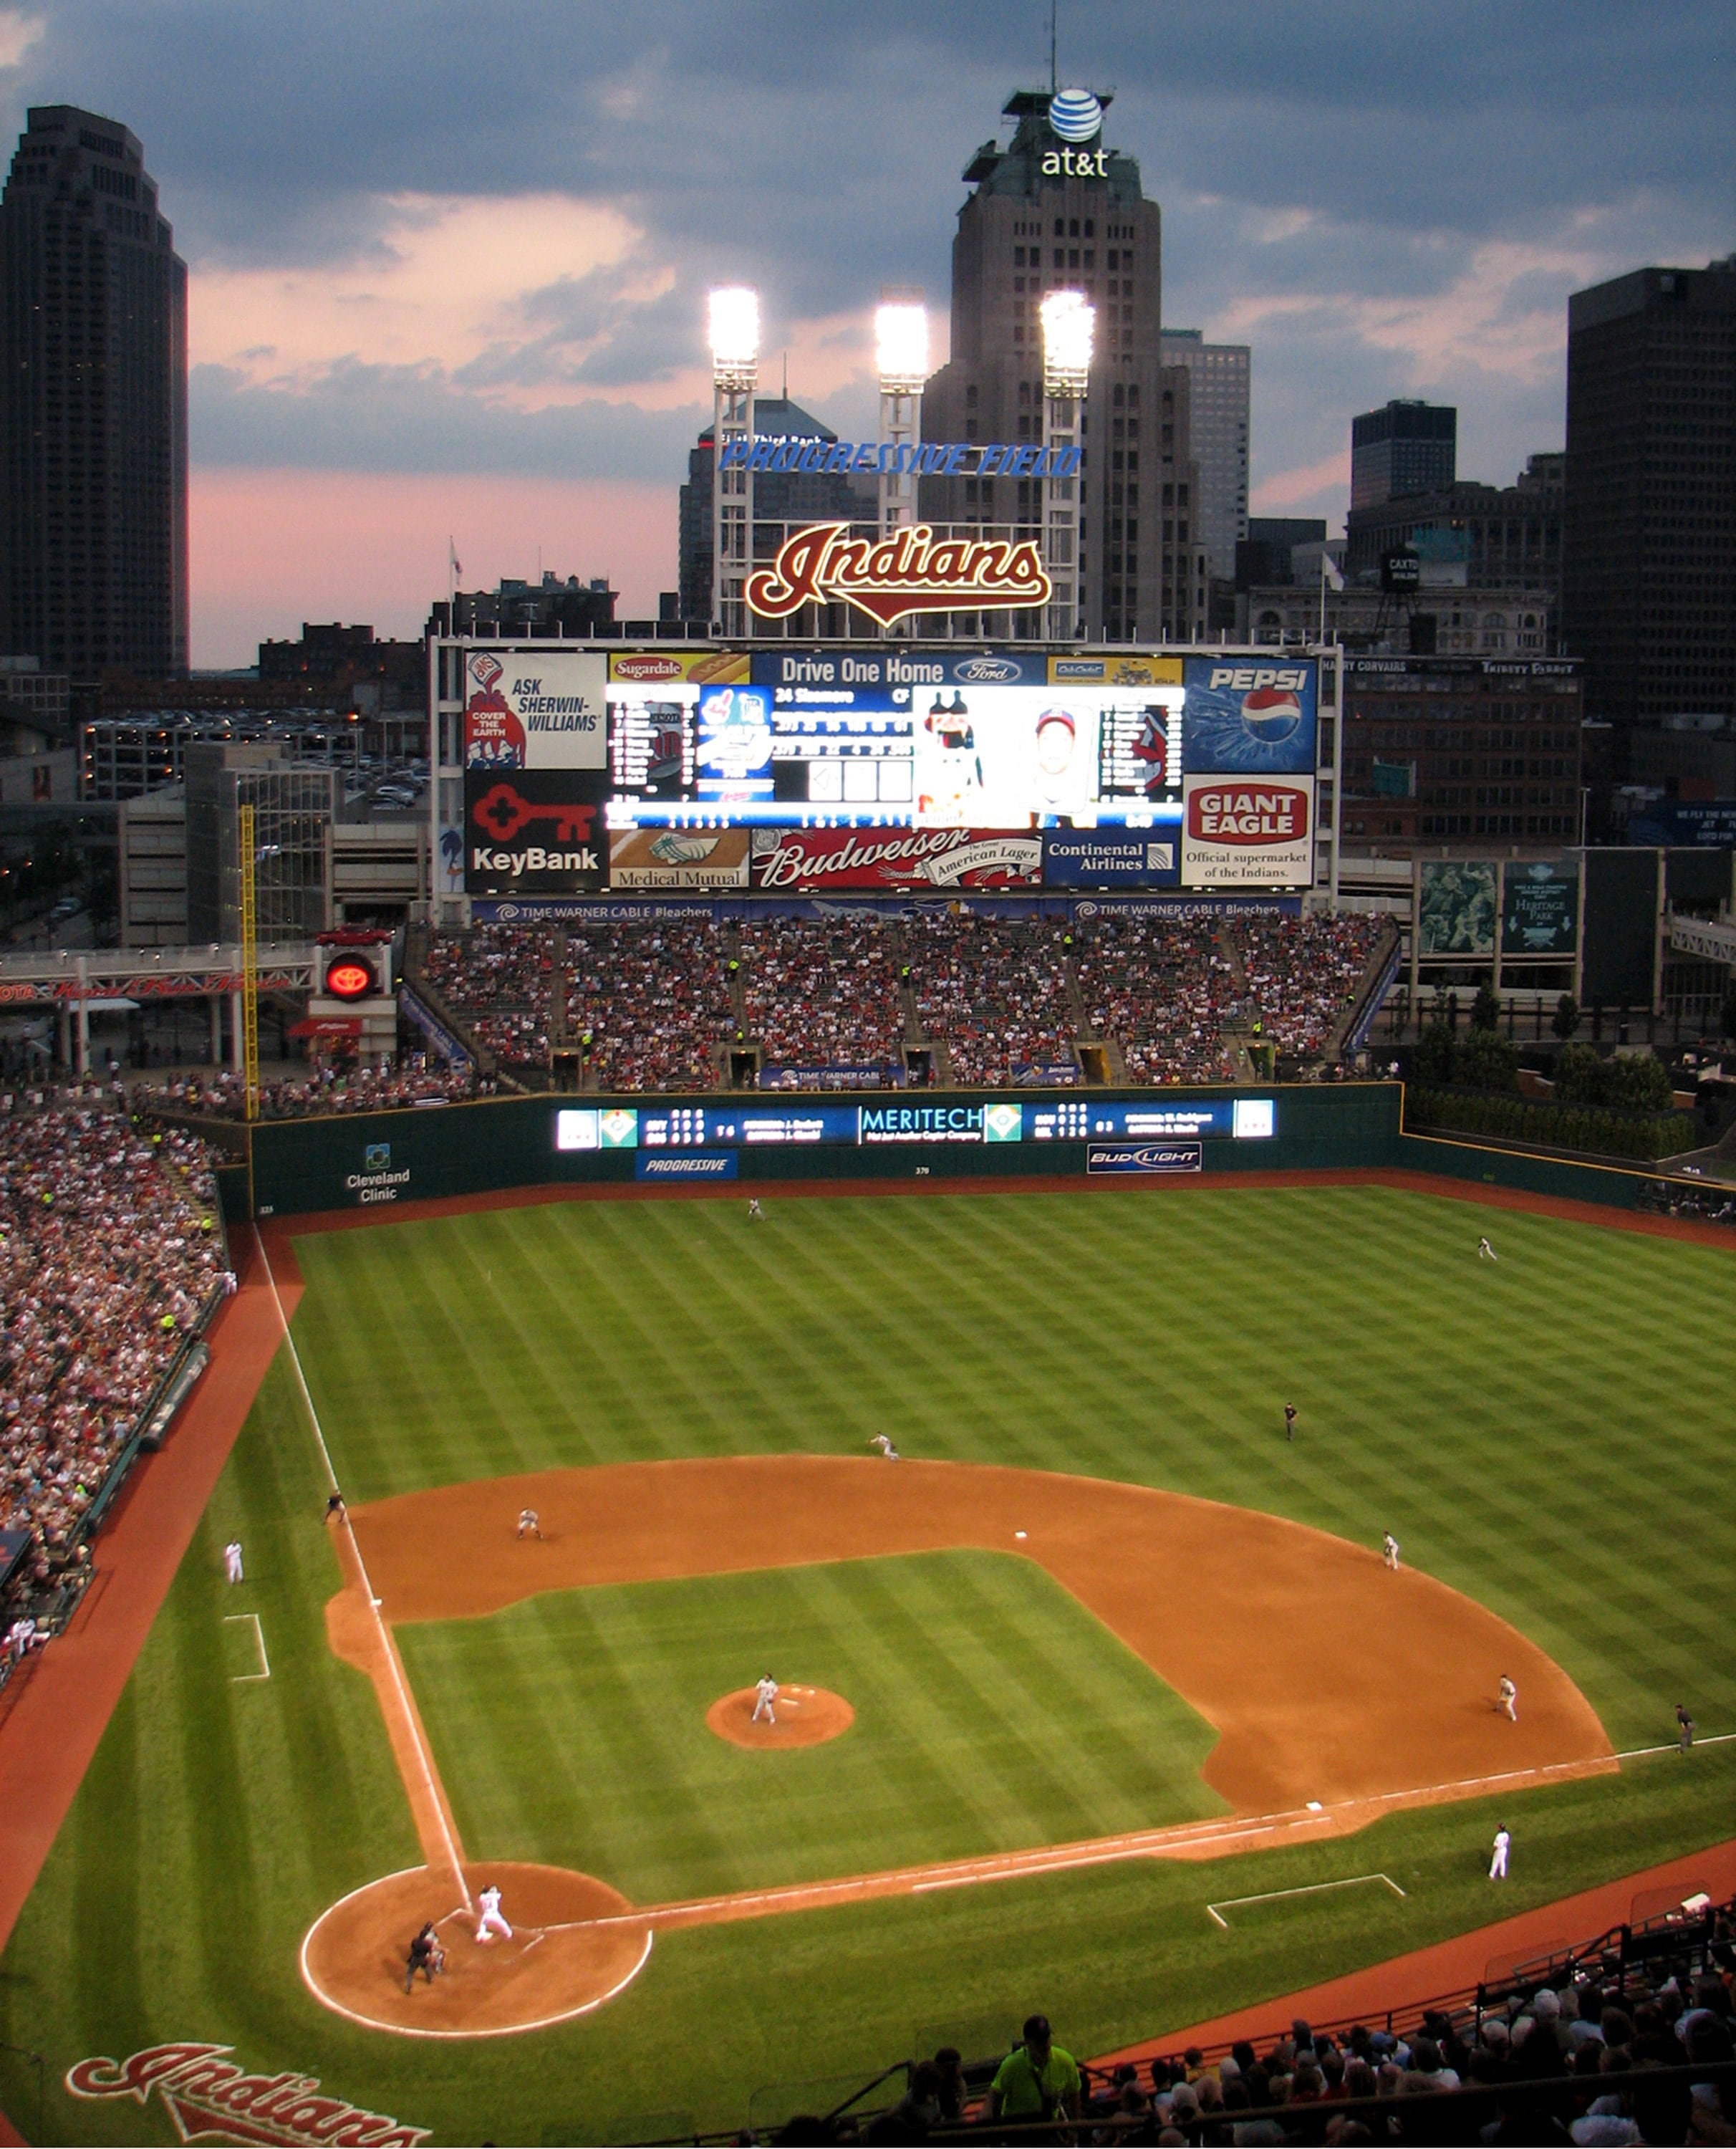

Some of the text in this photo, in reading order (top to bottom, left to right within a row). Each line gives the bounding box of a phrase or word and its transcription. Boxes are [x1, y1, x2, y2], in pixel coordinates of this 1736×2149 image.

[1041, 147, 1109, 177] at&t
[718, 441, 1082, 479] PROGRESSIVE FIELD
[744, 521, 1053, 628] Indians
[617, 660, 681, 678] Sugardale
[783, 658, 943, 683] Drive One Home
[966, 662, 1008, 681] Ford
[512, 678, 541, 696] ASK
[1210, 668, 1308, 690] PEPSI
[519, 697, 589, 713] SHERWIN-
[472, 712, 506, 721] COVER
[527, 715, 597, 731] WILLIAMS
[1199, 794, 1297, 814] GIANT
[1201, 815, 1293, 835] EAGLE
[752, 828, 970, 888] Budweiser
[1049, 843, 1143, 856] Continental
[1186, 852, 1307, 865] Official supermarket
[473, 847, 599, 878] KeyBank
[937, 846, 1038, 878] American Lager
[1080, 857, 1143, 871] Airlines
[619, 870, 741, 886] Medical Mutual
[1205, 867, 1289, 878] of the Indians.
[521, 906, 713, 918] TIME WARNER CABLE Bleachers
[1100, 905, 1129, 915] TIME
[1131, 905, 1182, 915] WARNER
[1226, 904, 1280, 915] Bleachers
[799, 1071, 819, 1080] TIME
[863, 1108, 983, 1130] MERITECH
[645, 1158, 728, 1173] PROGRESSIVE
[1090, 1151, 1198, 1163] BUD LIGHT
[347, 1168, 410, 1189] Cleveland
[360, 1184, 397, 1203] Clinic
